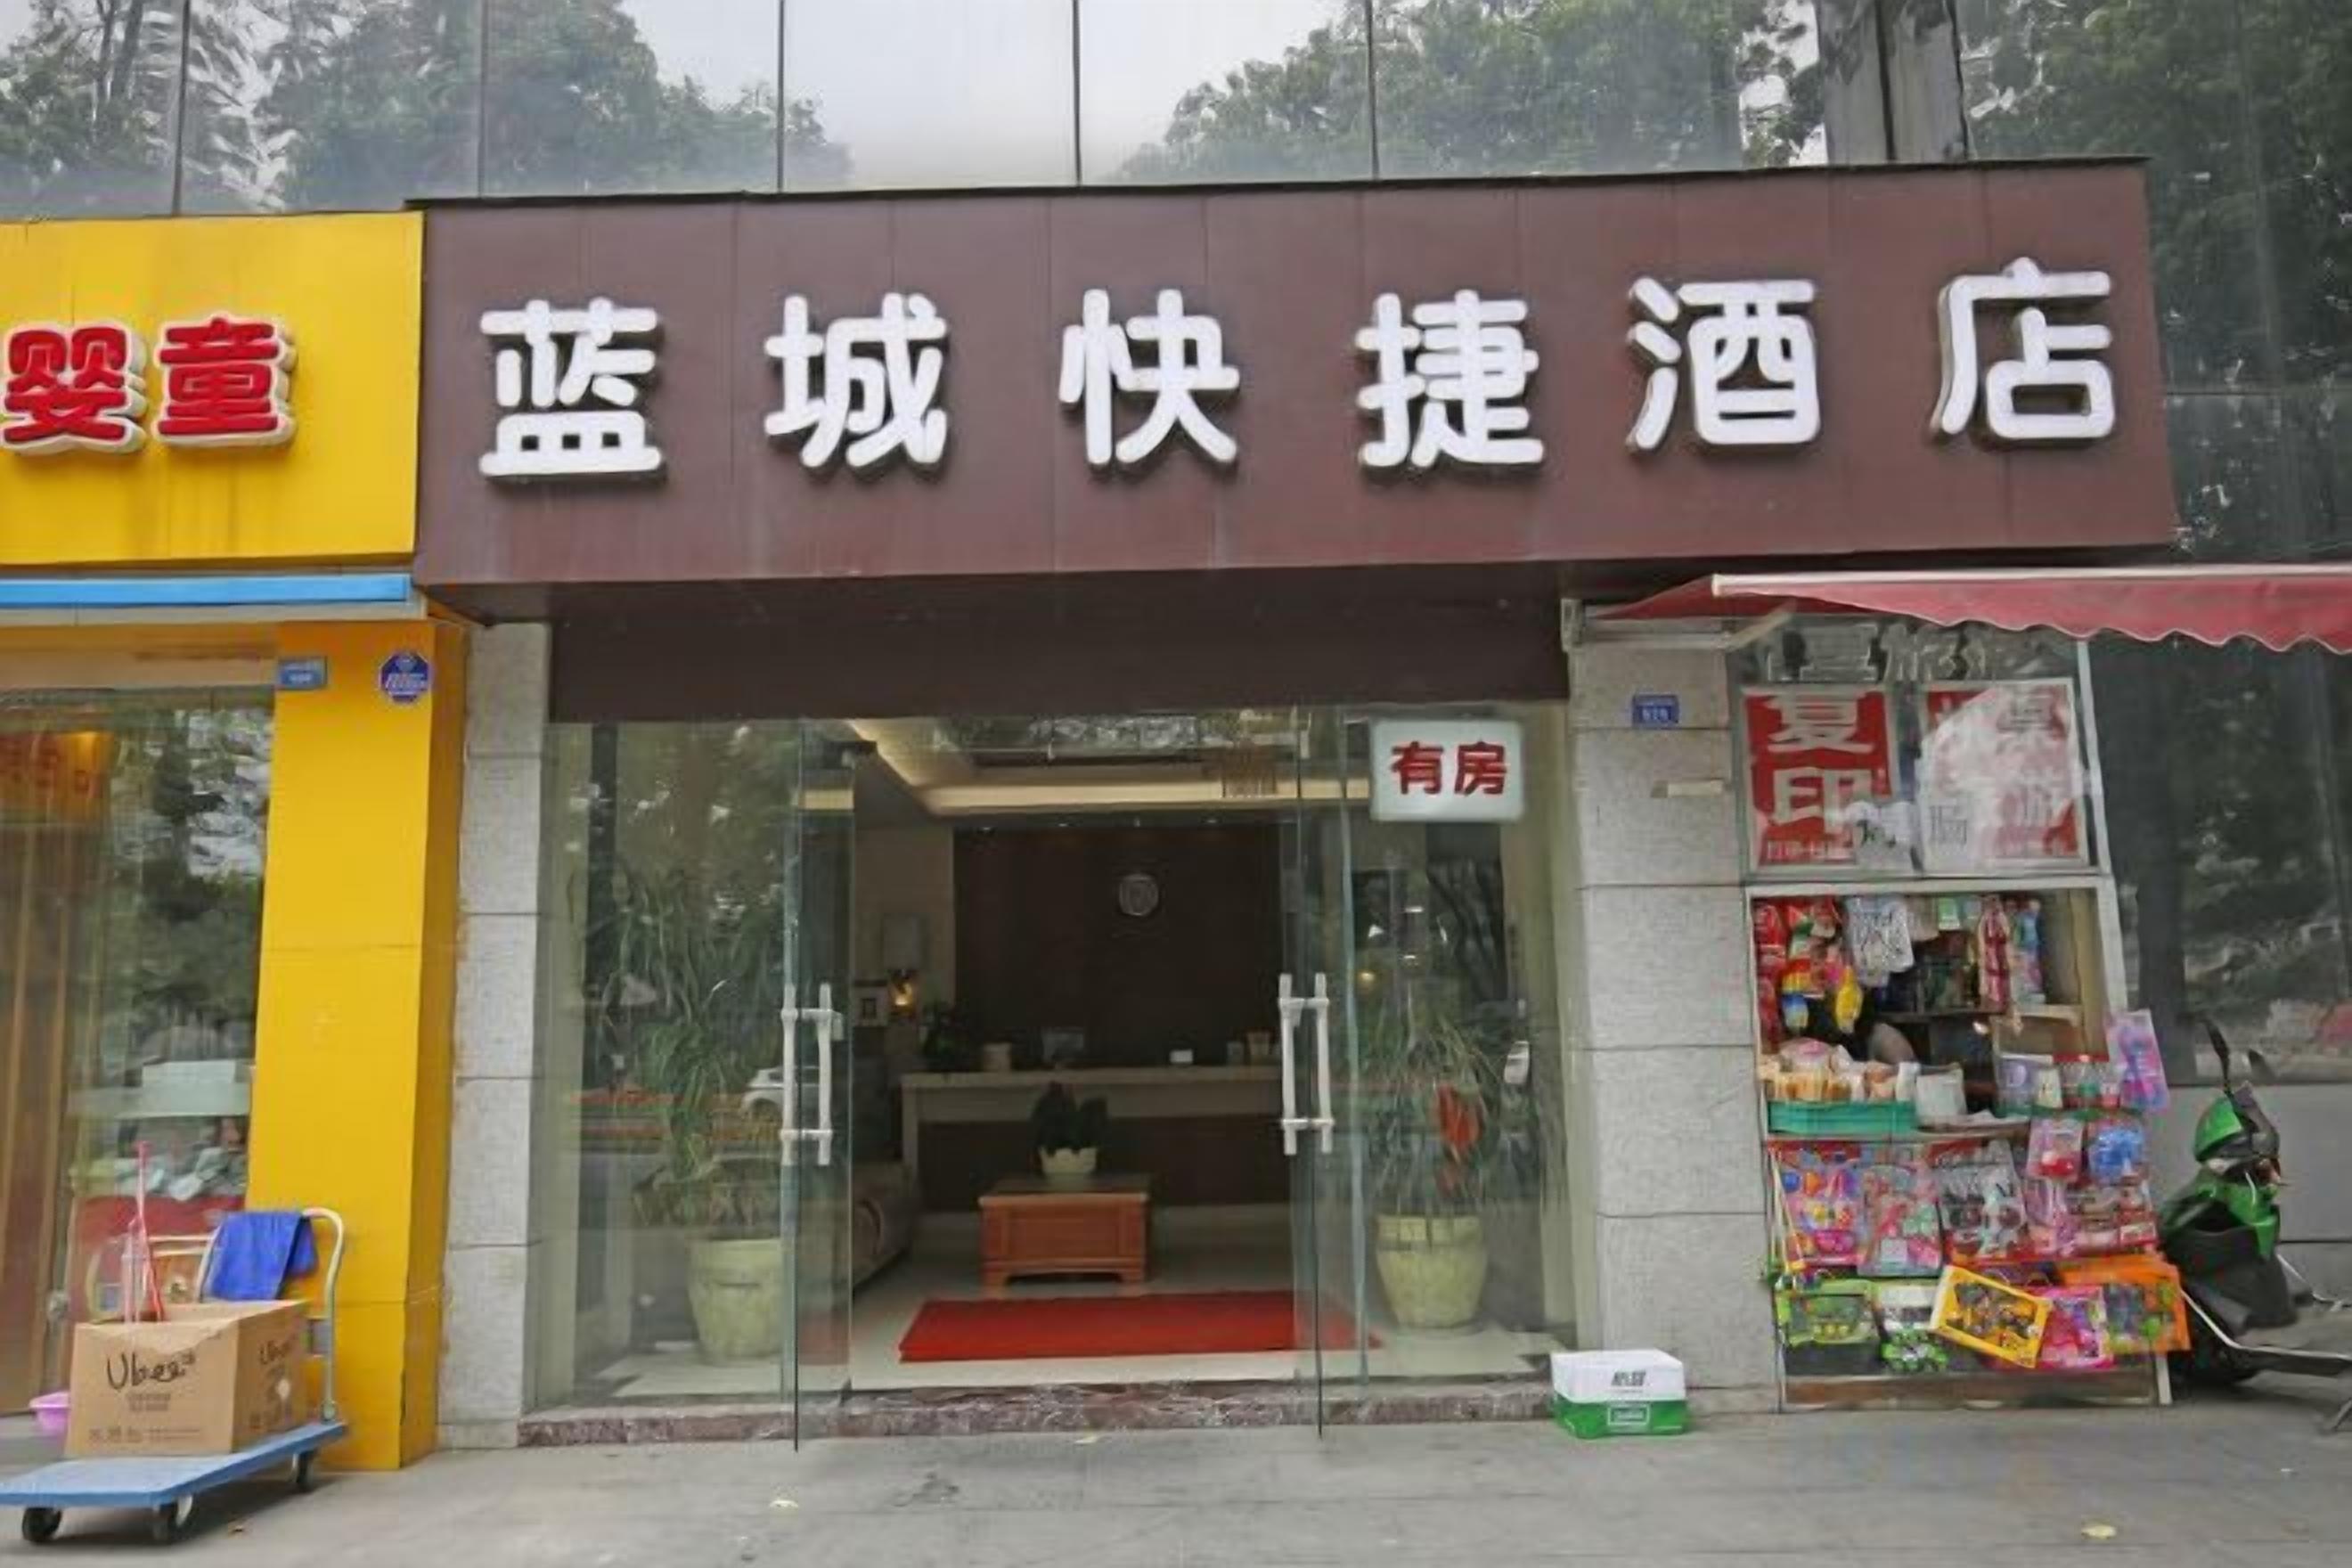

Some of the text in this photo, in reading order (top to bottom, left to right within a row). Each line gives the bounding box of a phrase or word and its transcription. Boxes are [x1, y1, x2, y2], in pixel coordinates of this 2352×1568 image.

[3, 312, 294, 453] 婴童
[479, 257, 2117, 478] 蓝城快捷酒店
[1390, 740, 1508, 796] 有房
